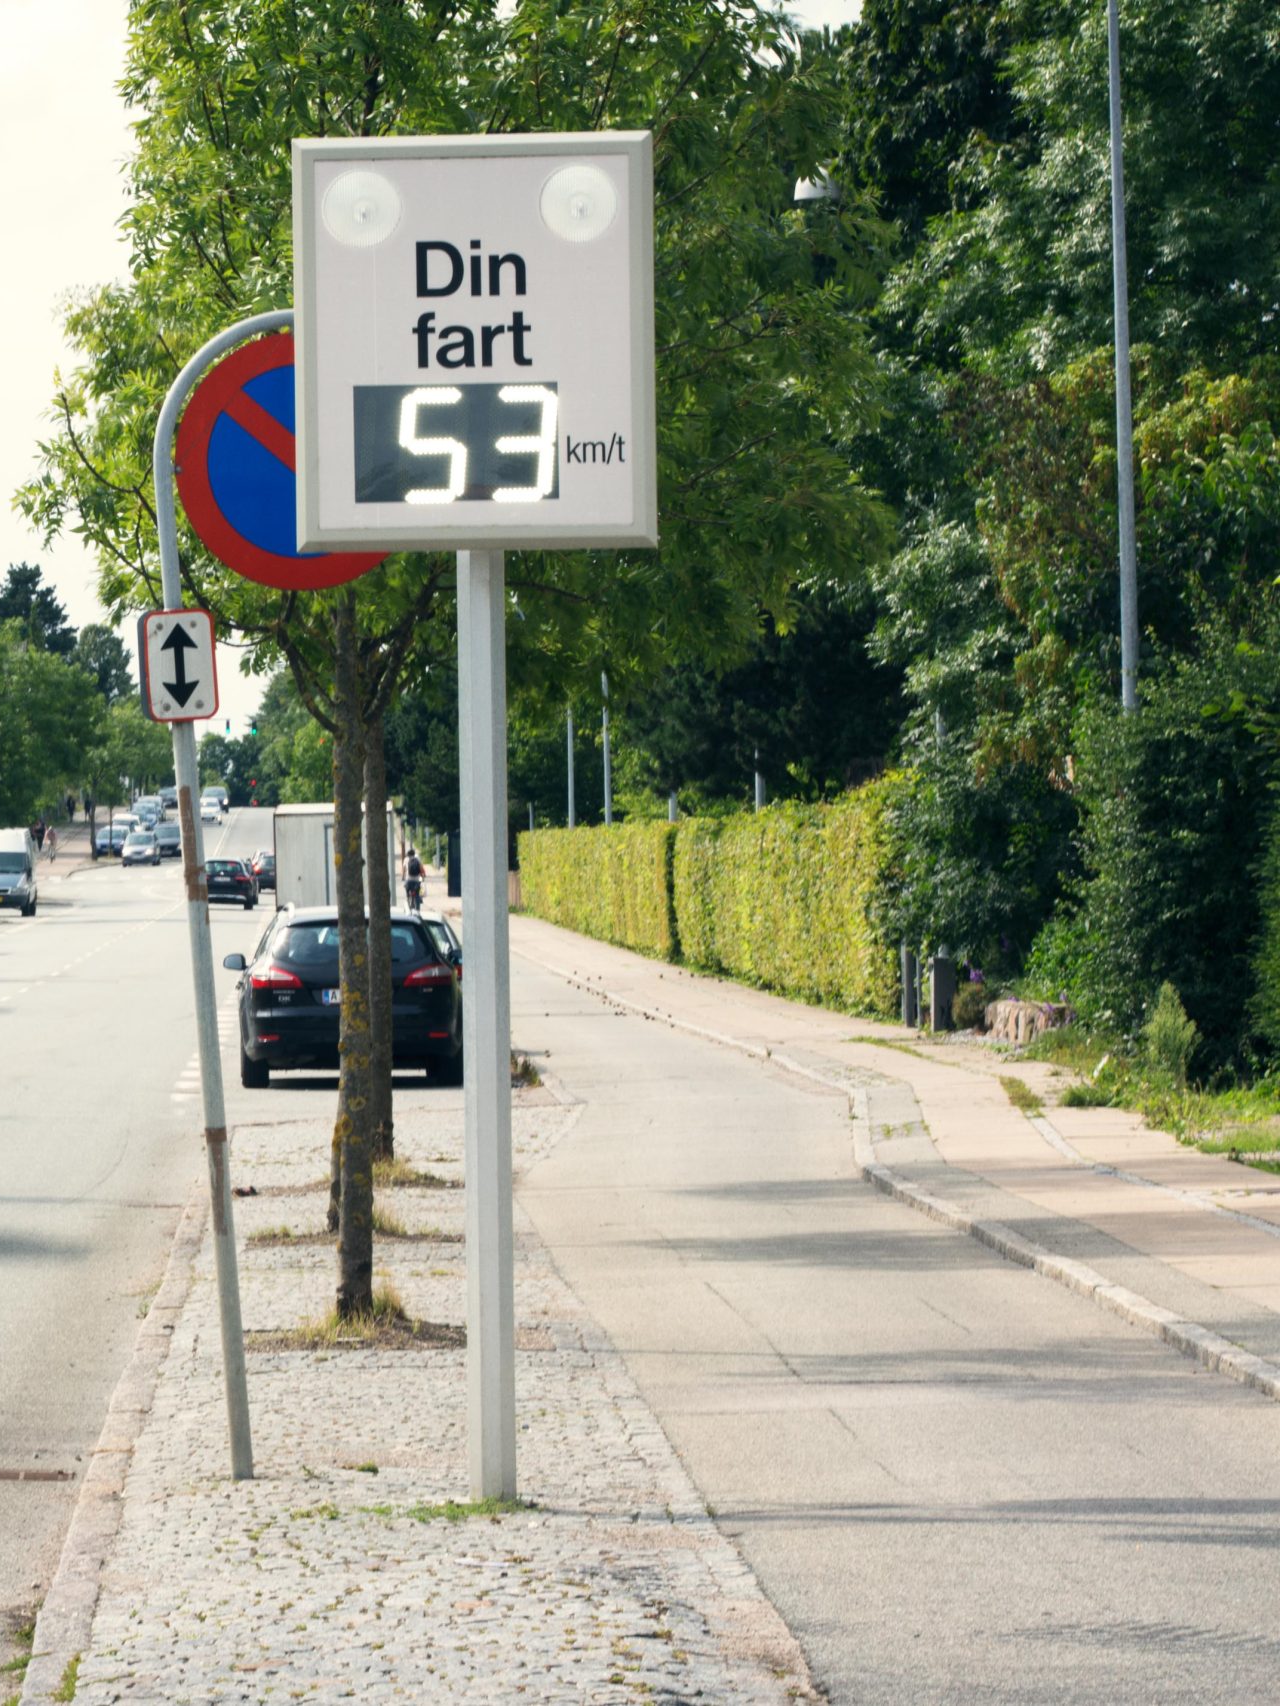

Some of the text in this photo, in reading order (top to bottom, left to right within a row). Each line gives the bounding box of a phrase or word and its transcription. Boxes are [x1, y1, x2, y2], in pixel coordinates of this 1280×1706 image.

[415, 239, 527, 298] Din
[412, 311, 533, 369] fart
[398, 385, 559, 505] 53
[566, 432, 626, 465] km/t
